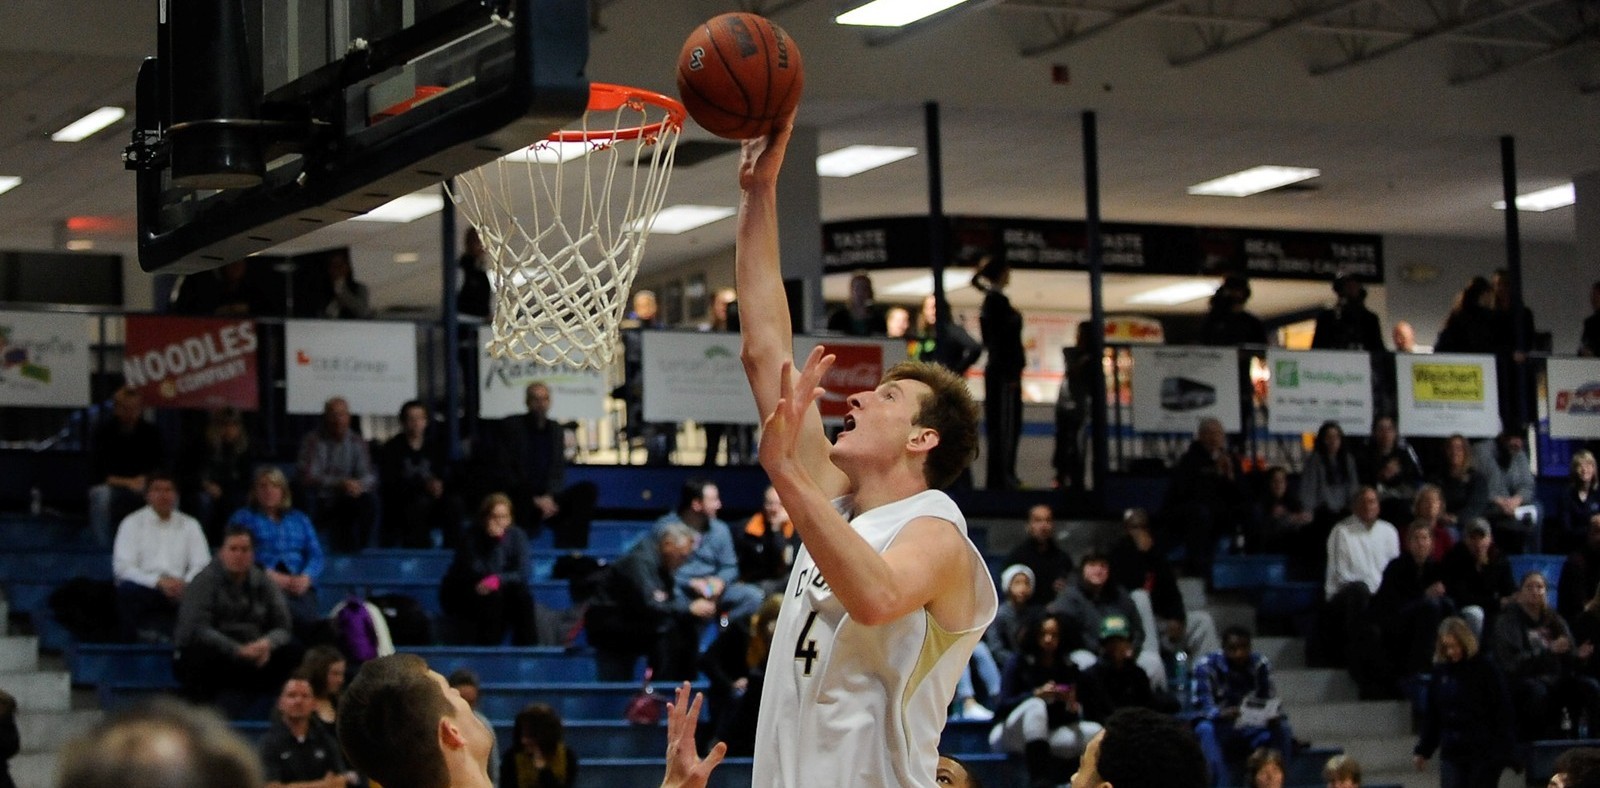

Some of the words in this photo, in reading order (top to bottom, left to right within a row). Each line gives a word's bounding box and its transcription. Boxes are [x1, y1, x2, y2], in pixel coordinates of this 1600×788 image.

[832, 229, 885, 249] TASTE
[1004, 229, 1046, 248] REAL
[1330, 243, 1375, 262] TASTE
[123, 321, 257, 389] NOODLES
[794, 610, 819, 677] 4
